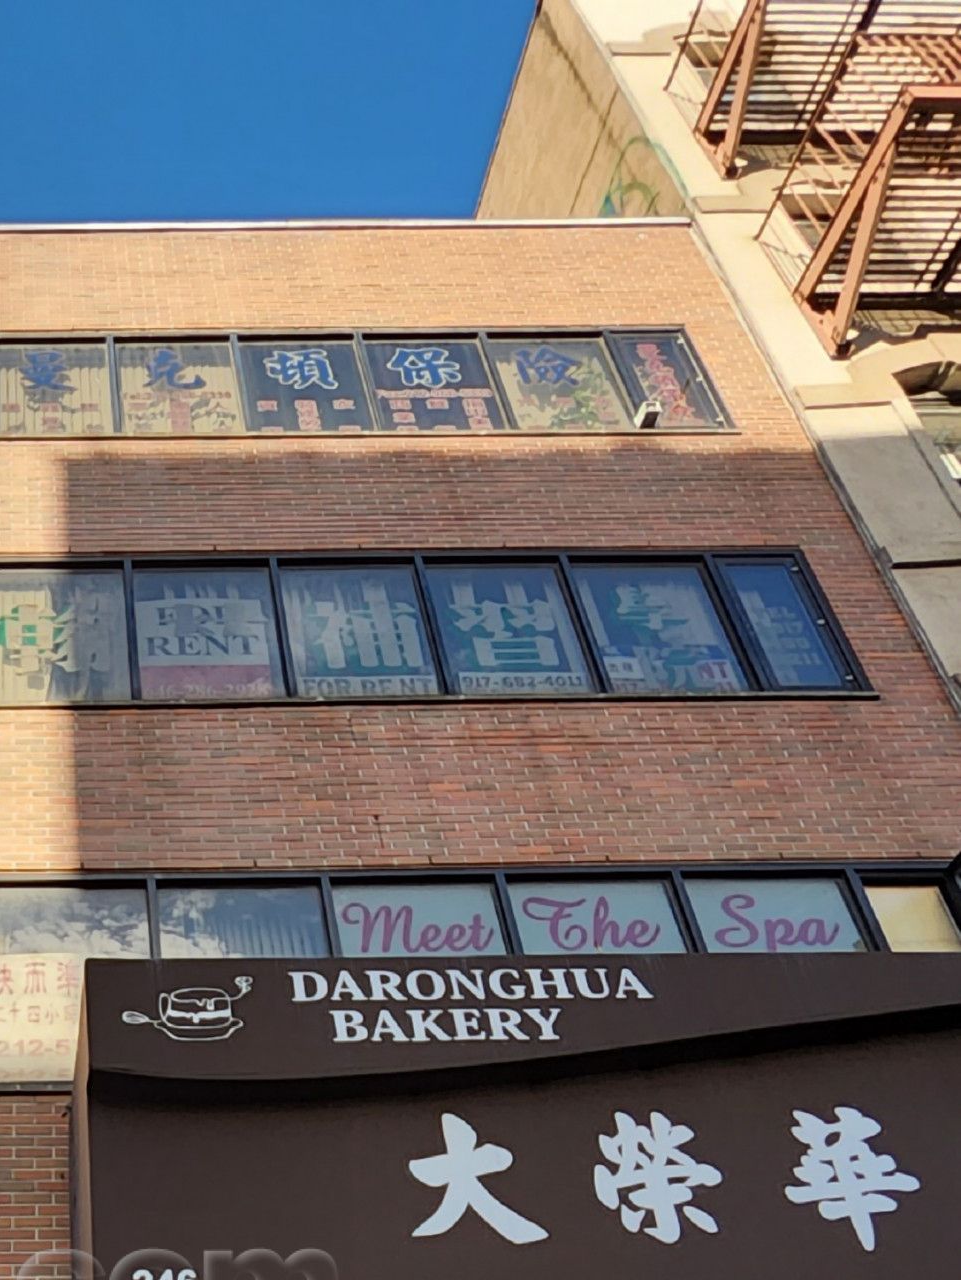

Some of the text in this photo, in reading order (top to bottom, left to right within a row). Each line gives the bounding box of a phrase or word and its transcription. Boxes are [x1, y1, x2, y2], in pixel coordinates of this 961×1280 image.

[145, 633, 260, 658] RENT
[341, 893, 841, 954] Meet The Spa
[290, 967, 654, 1004] DARONGHUA
[332, 1007, 562, 1043] BAKERY
[408, 1105, 921, 1251] 大榮華
